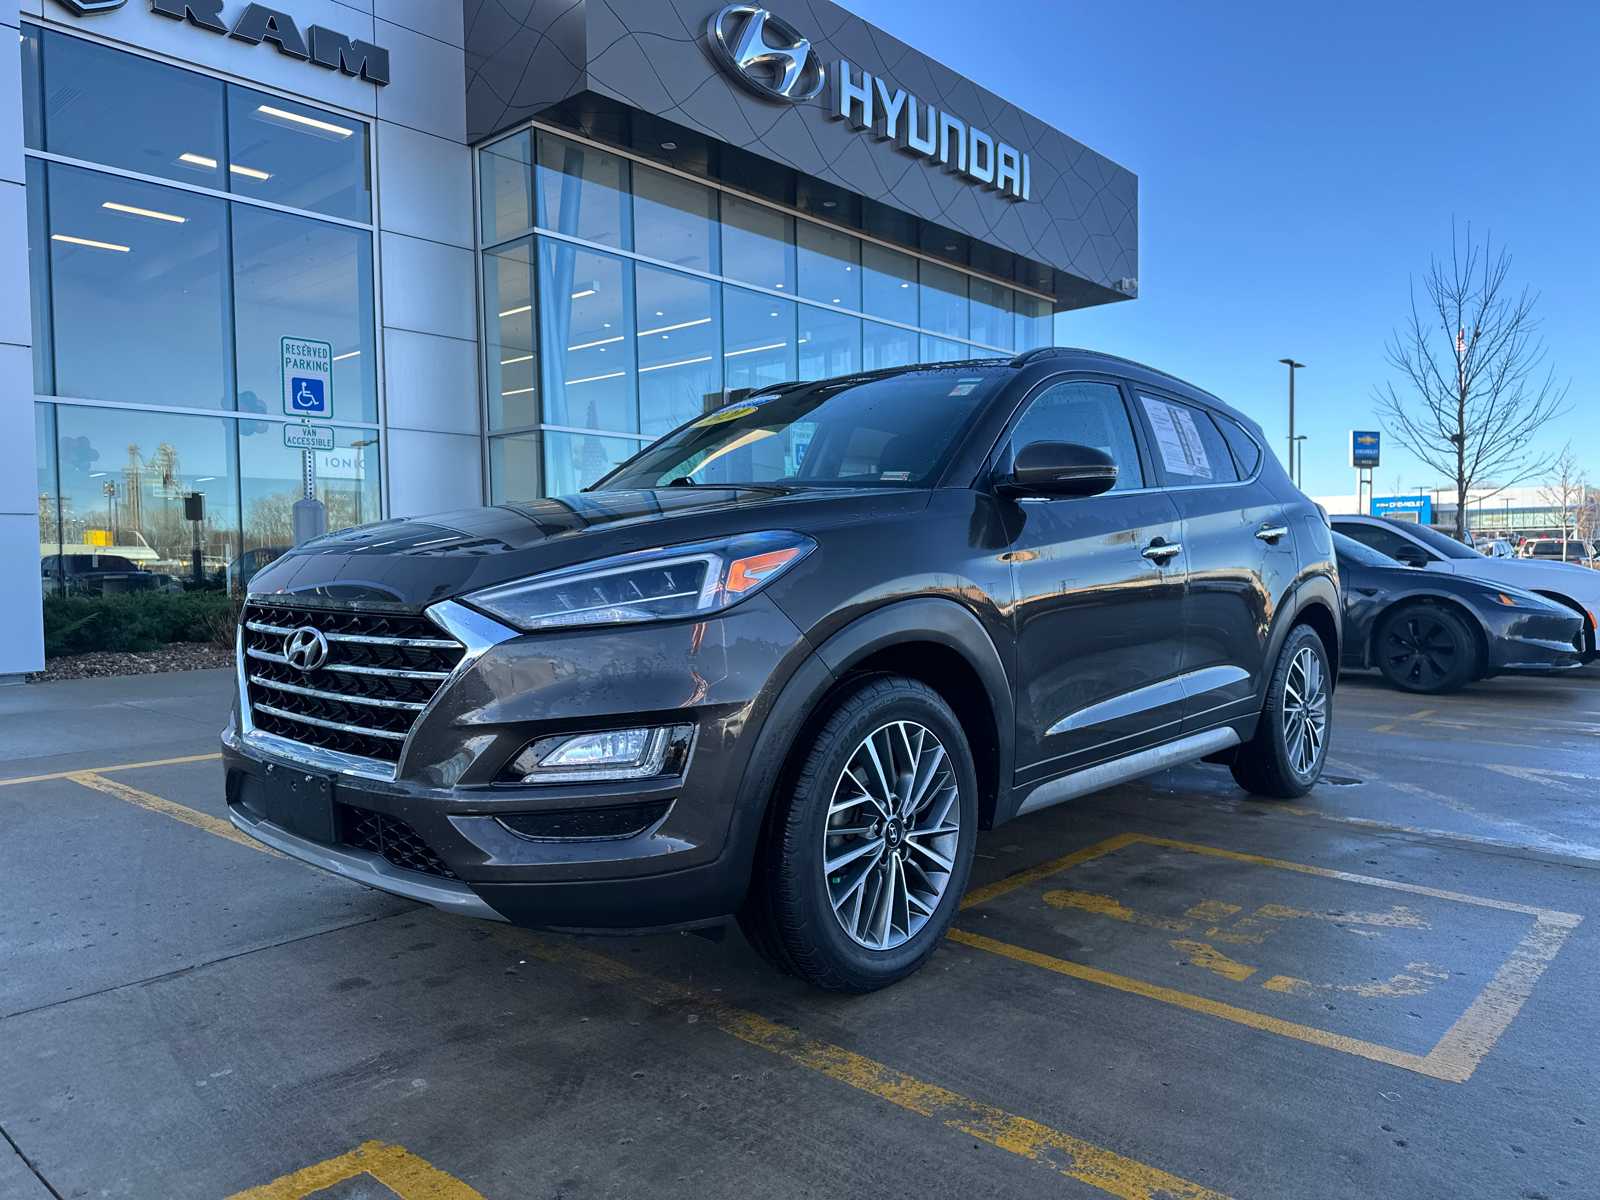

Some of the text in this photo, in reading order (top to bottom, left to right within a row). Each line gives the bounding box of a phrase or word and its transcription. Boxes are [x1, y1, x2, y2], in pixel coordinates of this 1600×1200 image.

[834, 59, 1031, 202] HYUNDAI
[285, 343, 328, 359] RESERVED
[285, 357, 329, 372] PARKING
[302, 428, 317, 437] VAN
[286, 436, 332, 447] ACCESSIBLE
[1389, 500, 1425, 508] CHEVROLET
